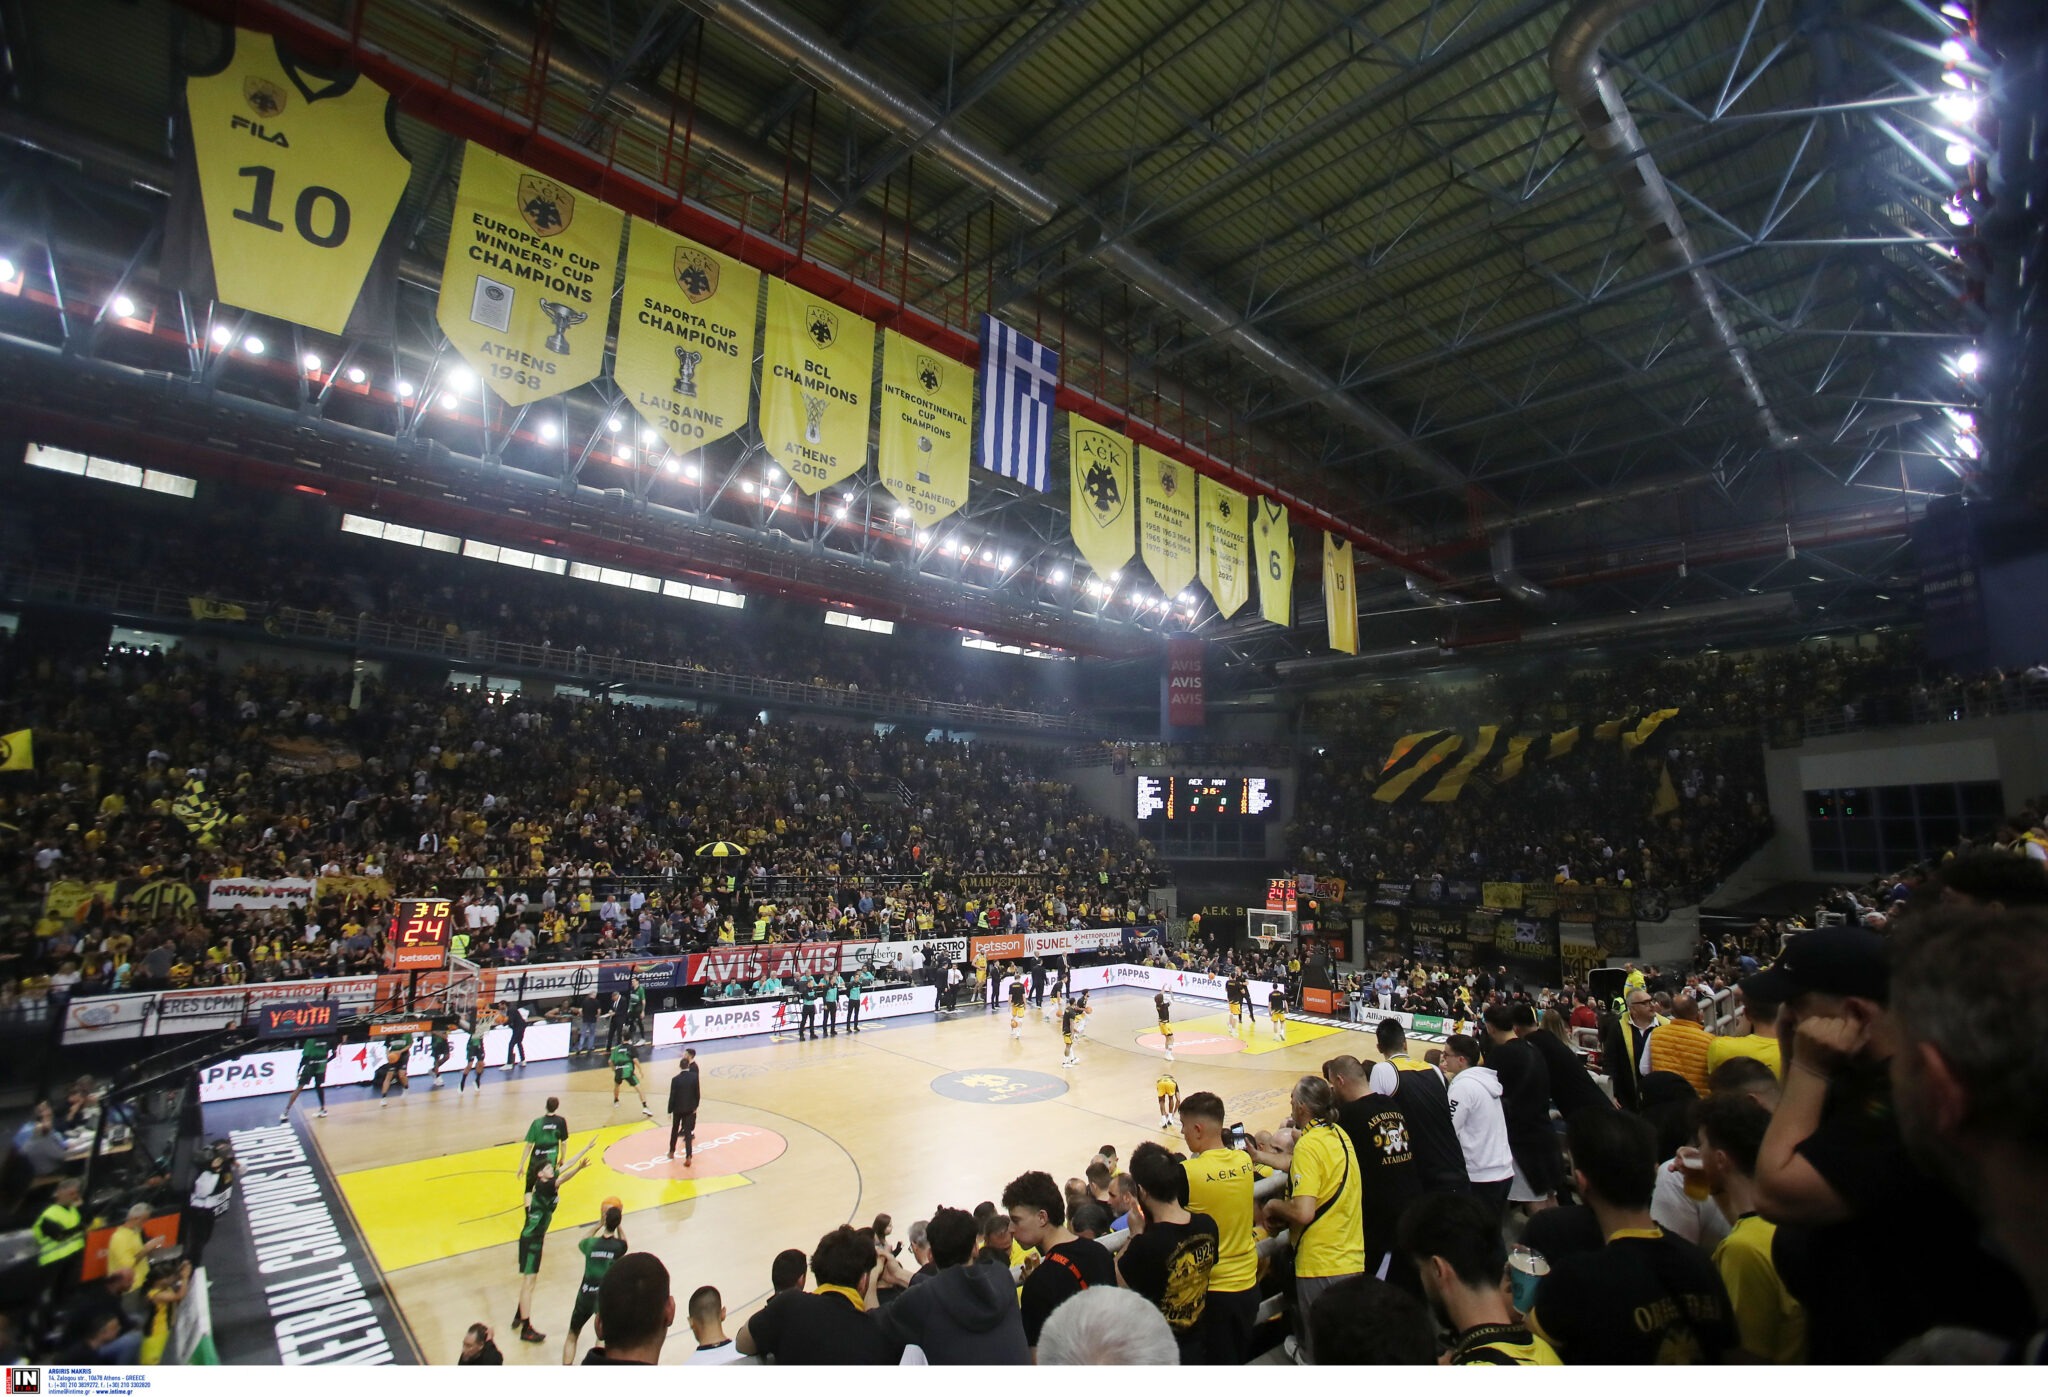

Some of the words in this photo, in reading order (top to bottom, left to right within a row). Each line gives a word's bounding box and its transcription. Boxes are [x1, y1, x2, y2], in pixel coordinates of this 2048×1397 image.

[231, 114, 289, 148] FILA
[232, 165, 351, 249] 10
[472, 212, 563, 259] EUROPEAN
[568, 252, 600, 272] CUP
[475, 229, 558, 270] WINNERS'
[562, 265, 594, 284] CUP
[468, 245, 593, 303] CHAMPIONS
[643, 297, 706, 329] SAPORTA
[710, 322, 737, 340] CUP
[637, 311, 739, 358] CHAMPIONS
[479, 340, 557, 376] ATHENS
[490, 363, 541, 391] 1968
[804, 359, 832, 381] BCL
[772, 364, 858, 406] CHAMPIONS
[639, 392, 724, 429] LAUSANNE
[884, 383, 968, 425] INTERCONTINENTAL
[918, 409, 936, 422] CUP
[657, 415, 706, 440] 2000
[901, 412, 951, 439] CHAMPIONS
[783, 441, 837, 467] ATHENS
[791, 459, 828, 481] 2018
[886, 477, 903, 489] RIO
[905, 483, 917, 494] DE
[918, 487, 956, 508] JANEIRO
[907, 496, 937, 515] 2019
[1268, 550, 1282, 581] 6
[1335, 572, 1345, 592] 13
[1171, 660, 1201, 672] AVIS
[1171, 677, 1202, 689] AVIS
[1171, 693, 1202, 705] AVIS
[1188, 779, 1204, 787] AEK
[1268, 888, 1283, 899] 24
[1201, 906, 1231, 916] A.E.K.
[403, 920, 444, 943] 24
[1080, 932, 1120, 940] METROPOLITAN
[922, 940, 966, 952] AESTRO
[975, 940, 1021, 953] betsson
[1036, 937, 1072, 950] SUNEL
[399, 953, 441, 963] betsson
[692, 952, 763, 983] AVIS
[776, 946, 838, 976] AVIS
[1117, 968, 1150, 980] PAPPAS
[1192, 976, 1222, 988] PAPPAS
[879, 992, 914, 1005] PAPPAS
[380, 1024, 421, 1033] betsson
[704, 1010, 761, 1027] PAPPAS
[228, 1122, 308, 1172] LEAGUE
[239, 1164, 348, 1275] CHAMPIONS
